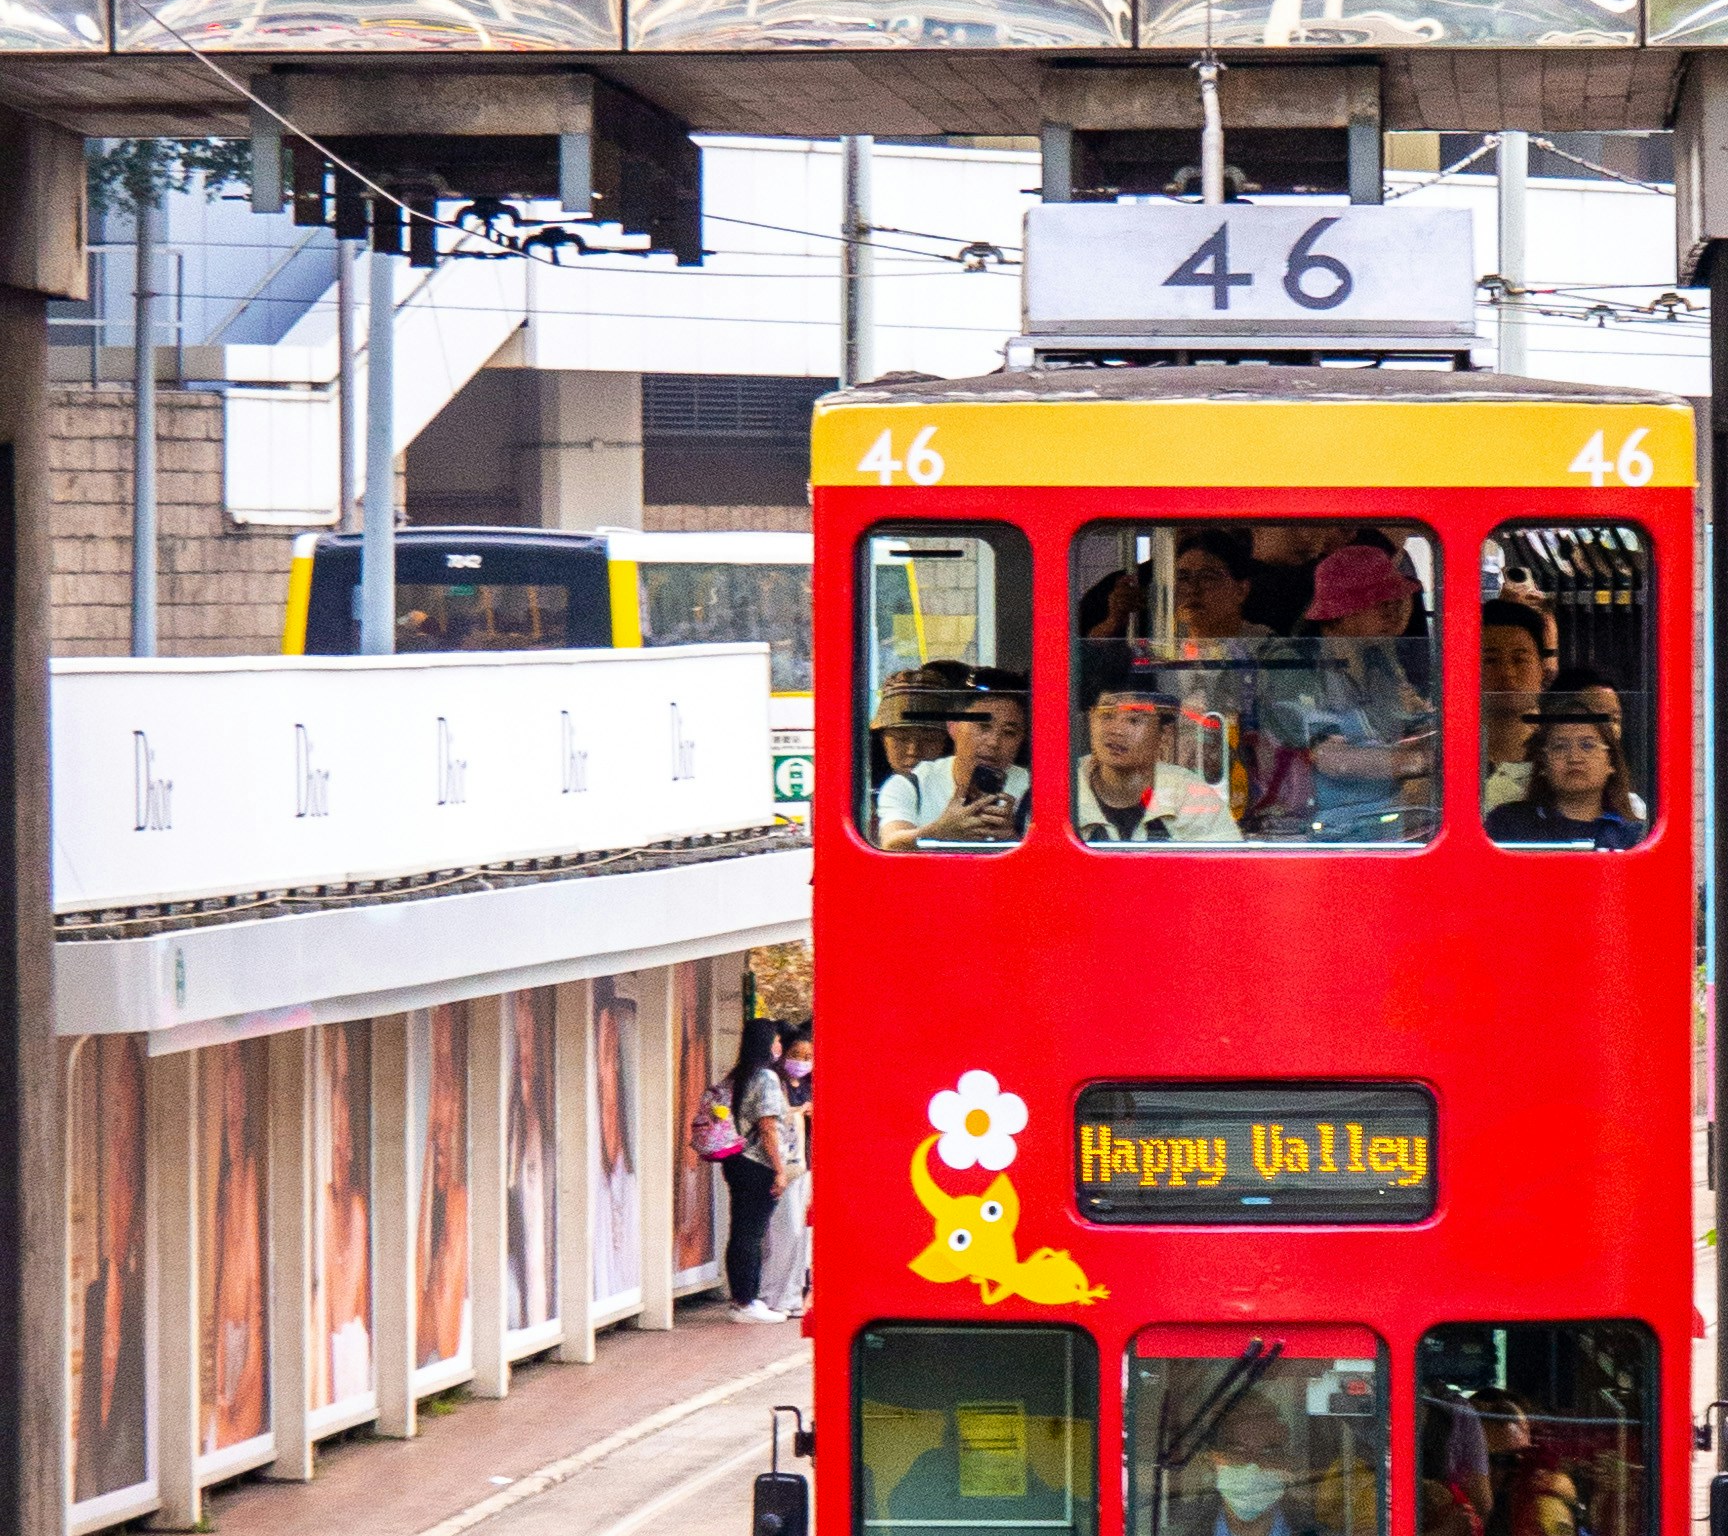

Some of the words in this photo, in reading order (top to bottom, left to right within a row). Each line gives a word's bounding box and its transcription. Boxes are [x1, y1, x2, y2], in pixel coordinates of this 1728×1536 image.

[1161, 217, 1354, 310] 46
[857, 425, 945, 486] 46
[1567, 426, 1654, 487] 46
[1080, 1124, 1227, 1187] Happy
[1251, 1122, 1427, 1187] Valley
